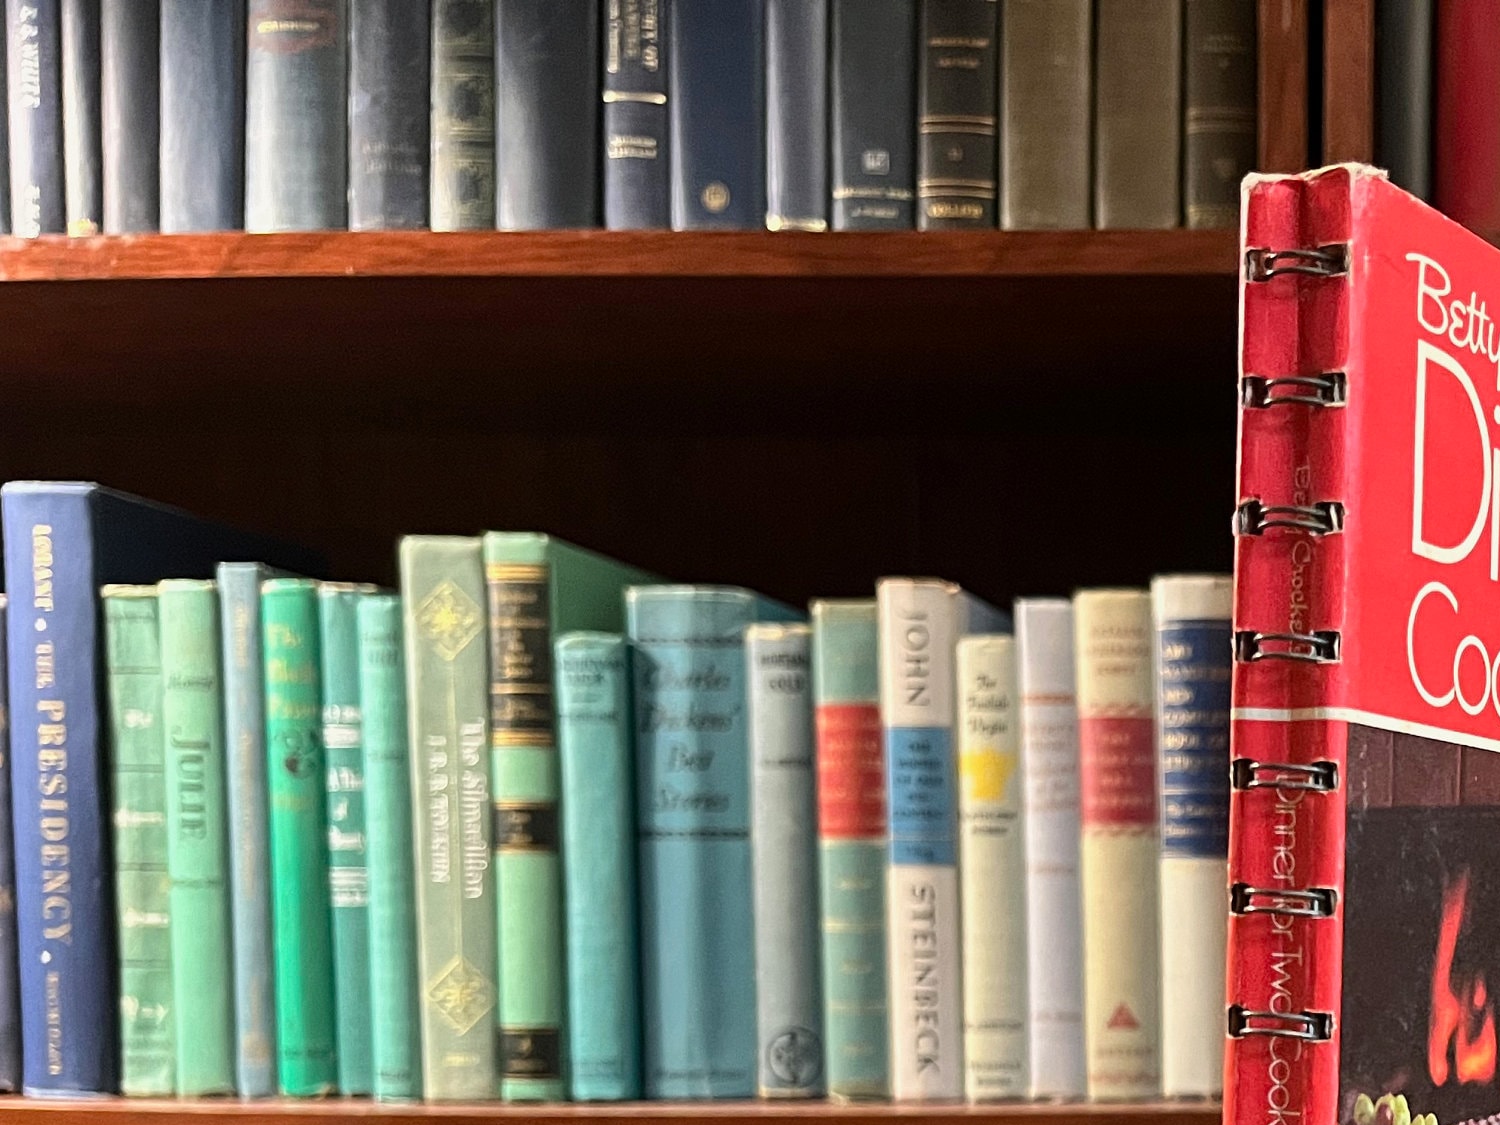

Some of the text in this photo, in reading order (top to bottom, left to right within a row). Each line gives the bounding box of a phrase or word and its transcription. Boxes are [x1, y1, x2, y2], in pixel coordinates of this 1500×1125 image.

[897, 609, 930, 707] JOHN
[36, 700, 72, 945] PRESIDENCY
[1272, 773, 1307, 887] Dinner
[911, 884, 941, 1075] STEINBECK
[1269, 944, 1303, 1017] Two
